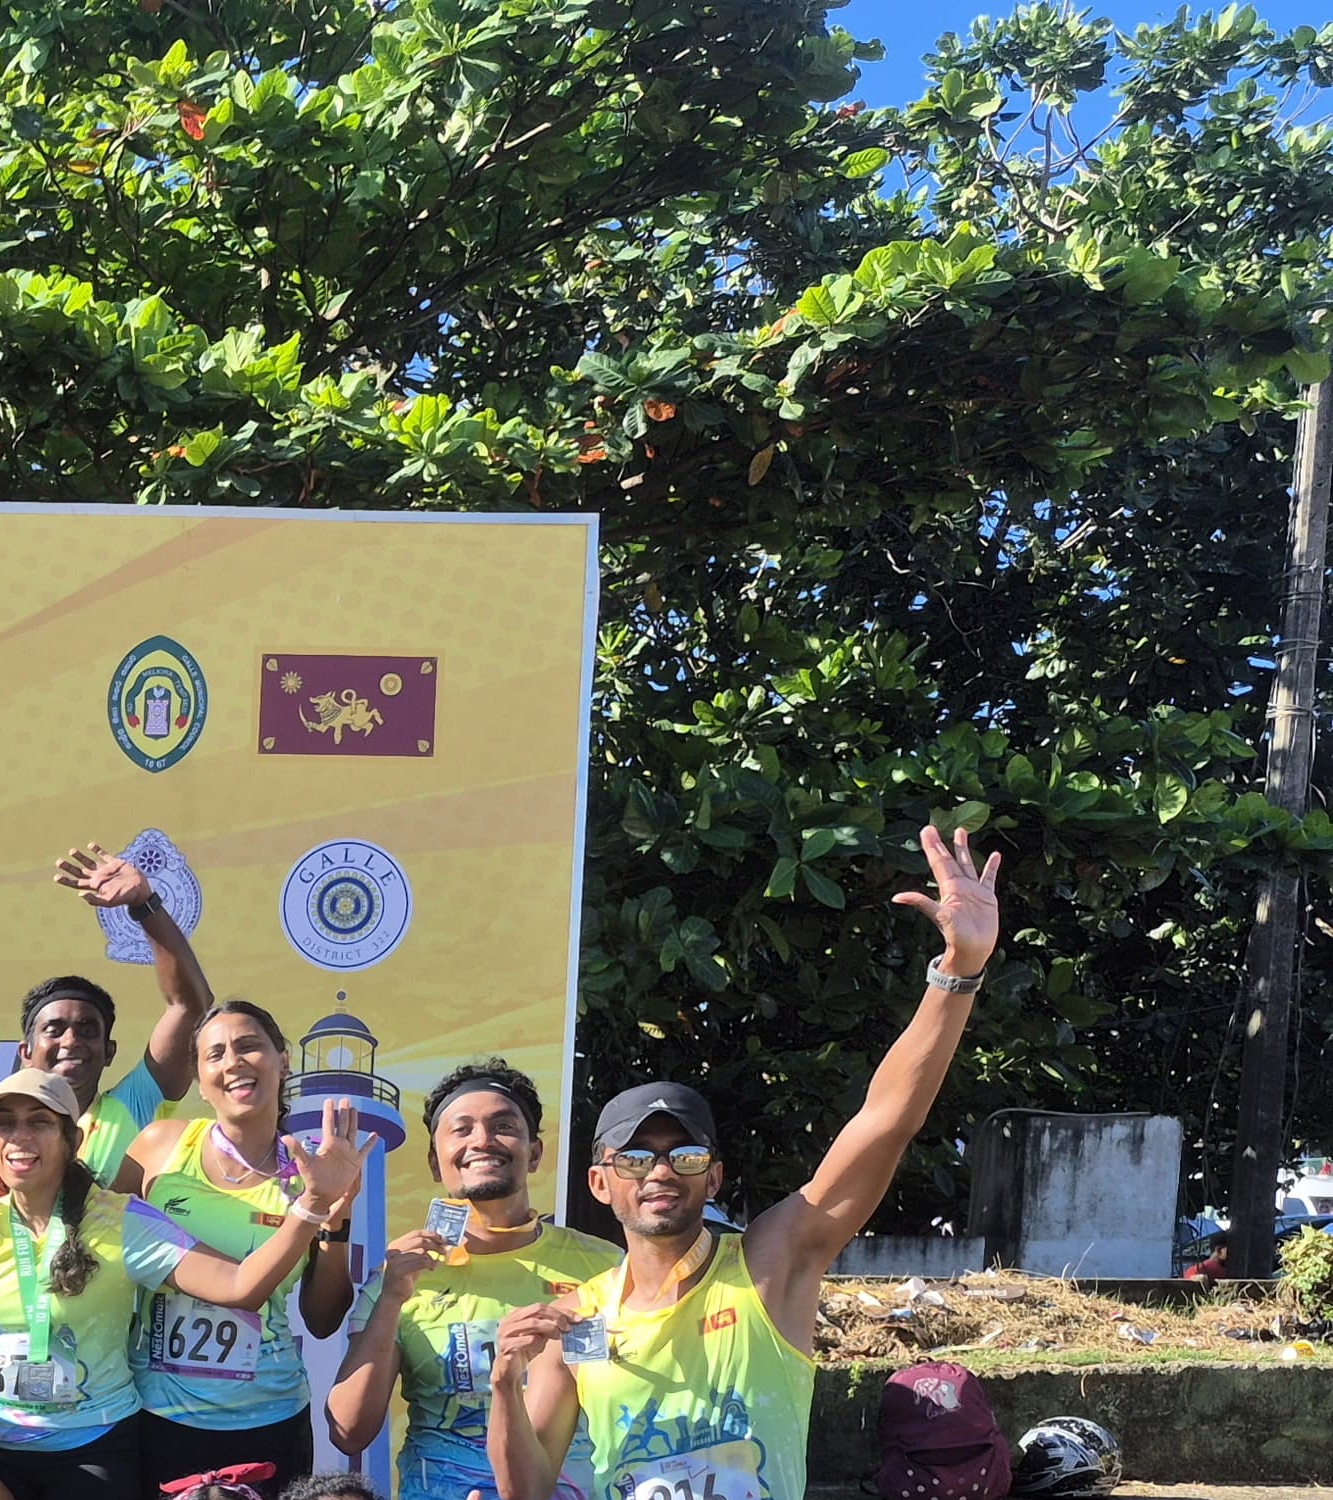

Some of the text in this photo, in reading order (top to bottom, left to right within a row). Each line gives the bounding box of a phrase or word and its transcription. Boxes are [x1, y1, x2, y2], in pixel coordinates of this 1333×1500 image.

[299, 848, 397, 886] GALLE
[303, 937, 362, 960] DISTRICT
[17, 1243, 31, 1278] RUN FOR
[35, 1294, 48, 1324] 10 KM
[169, 1317, 238, 1364] 629
